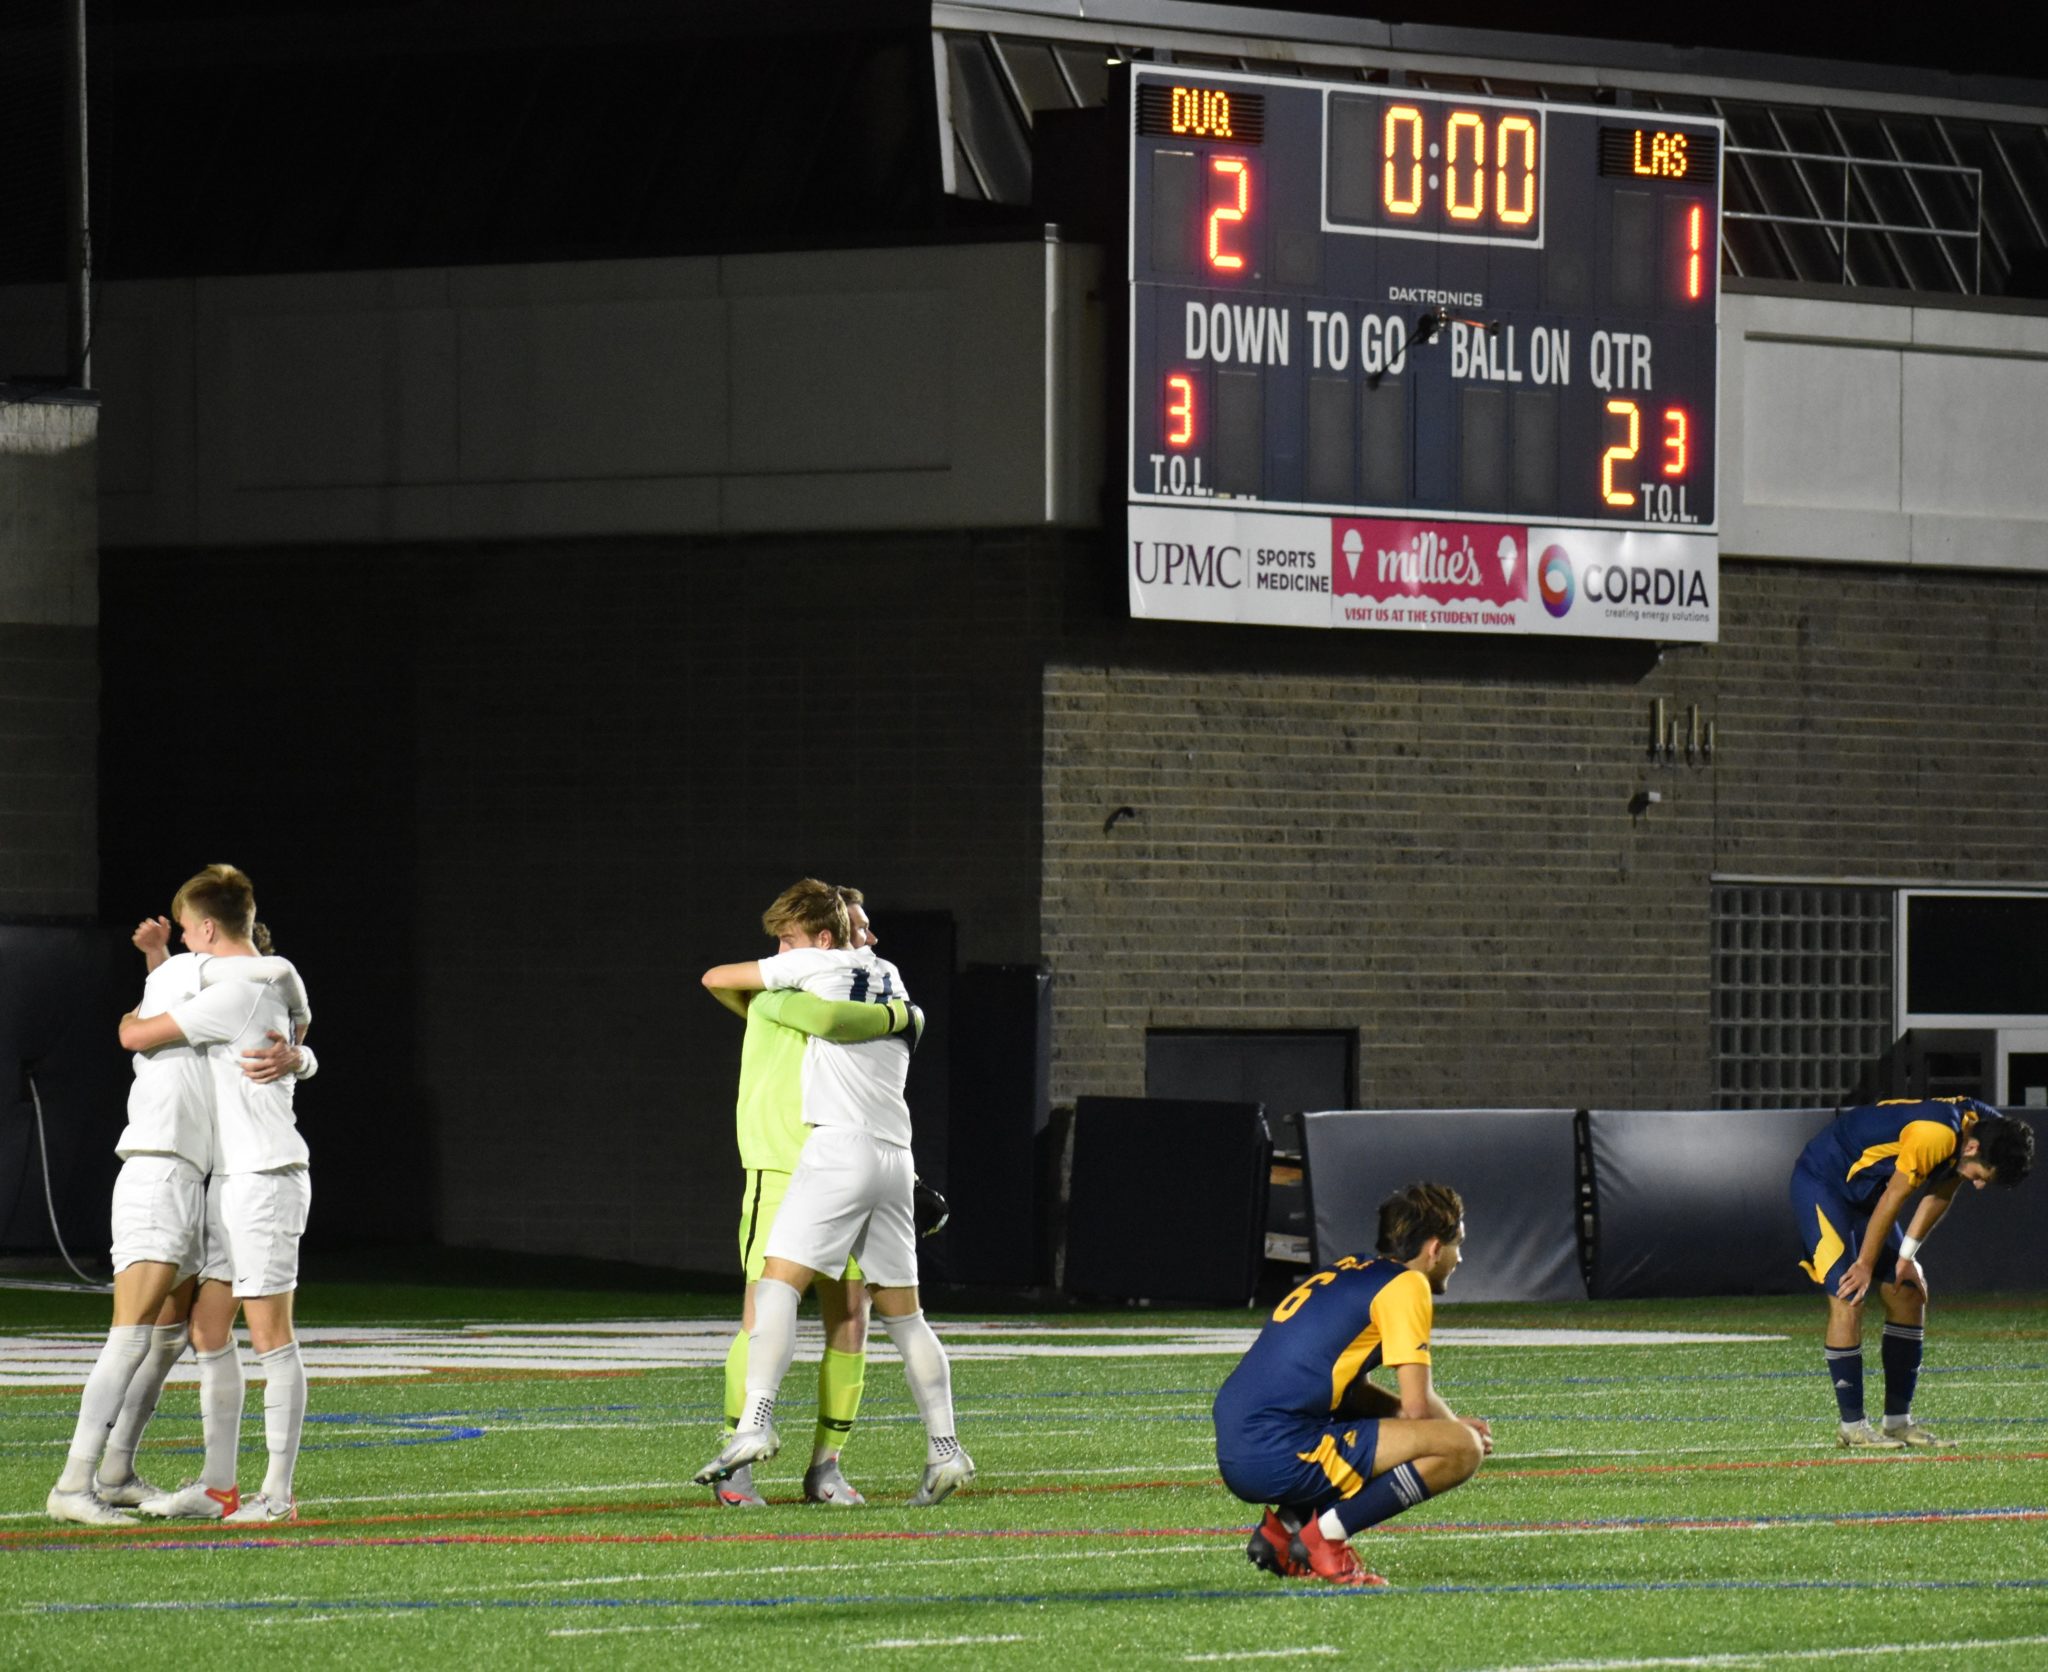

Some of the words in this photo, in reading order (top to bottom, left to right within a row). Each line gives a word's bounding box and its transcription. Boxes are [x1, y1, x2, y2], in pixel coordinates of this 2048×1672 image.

[1384, 105, 1536, 225] 0:00
[1634, 129, 1688, 177] LAS
[1208, 158, 1248, 269] 2
[1687, 205, 1701, 299] 1
[1388, 287, 1484, 306] DAKTRONICS
[1186, 301, 1290, 366] DOWN
[1307, 310, 1350, 371] TO
[1361, 314, 1406, 374] GO
[1451, 321, 1523, 382] BALL
[1530, 326, 1570, 385] ON
[1590, 330, 1652, 392] QTR
[1168, 377, 1193, 444] 3
[1602, 400, 1640, 506] 2
[1663, 409, 1687, 475] 3
[1150, 454, 1214, 496] T.O.L.
[1641, 483, 1698, 524] T.O.L.
[1134, 541, 1242, 589] UPMC
[1257, 549, 1316, 569] SPORTS
[1257, 573, 1329, 593] MEDICINE
[1377, 531, 1482, 586] millie's
[1583, 564, 1710, 608] CORDIA
[1345, 608, 1373, 621] VISIT
[1375, 609, 1389, 622] US
[1391, 610, 1404, 622] AT
[1408, 610, 1428, 624] THE
[1430, 611, 1479, 625] STUDENT
[1482, 613, 1516, 626] UNION
[1604, 608, 1639, 621] creating
[1641, 610, 1670, 622] energy
[1672, 611, 1710, 622] solutions
[1272, 1271, 1338, 1324] 6
